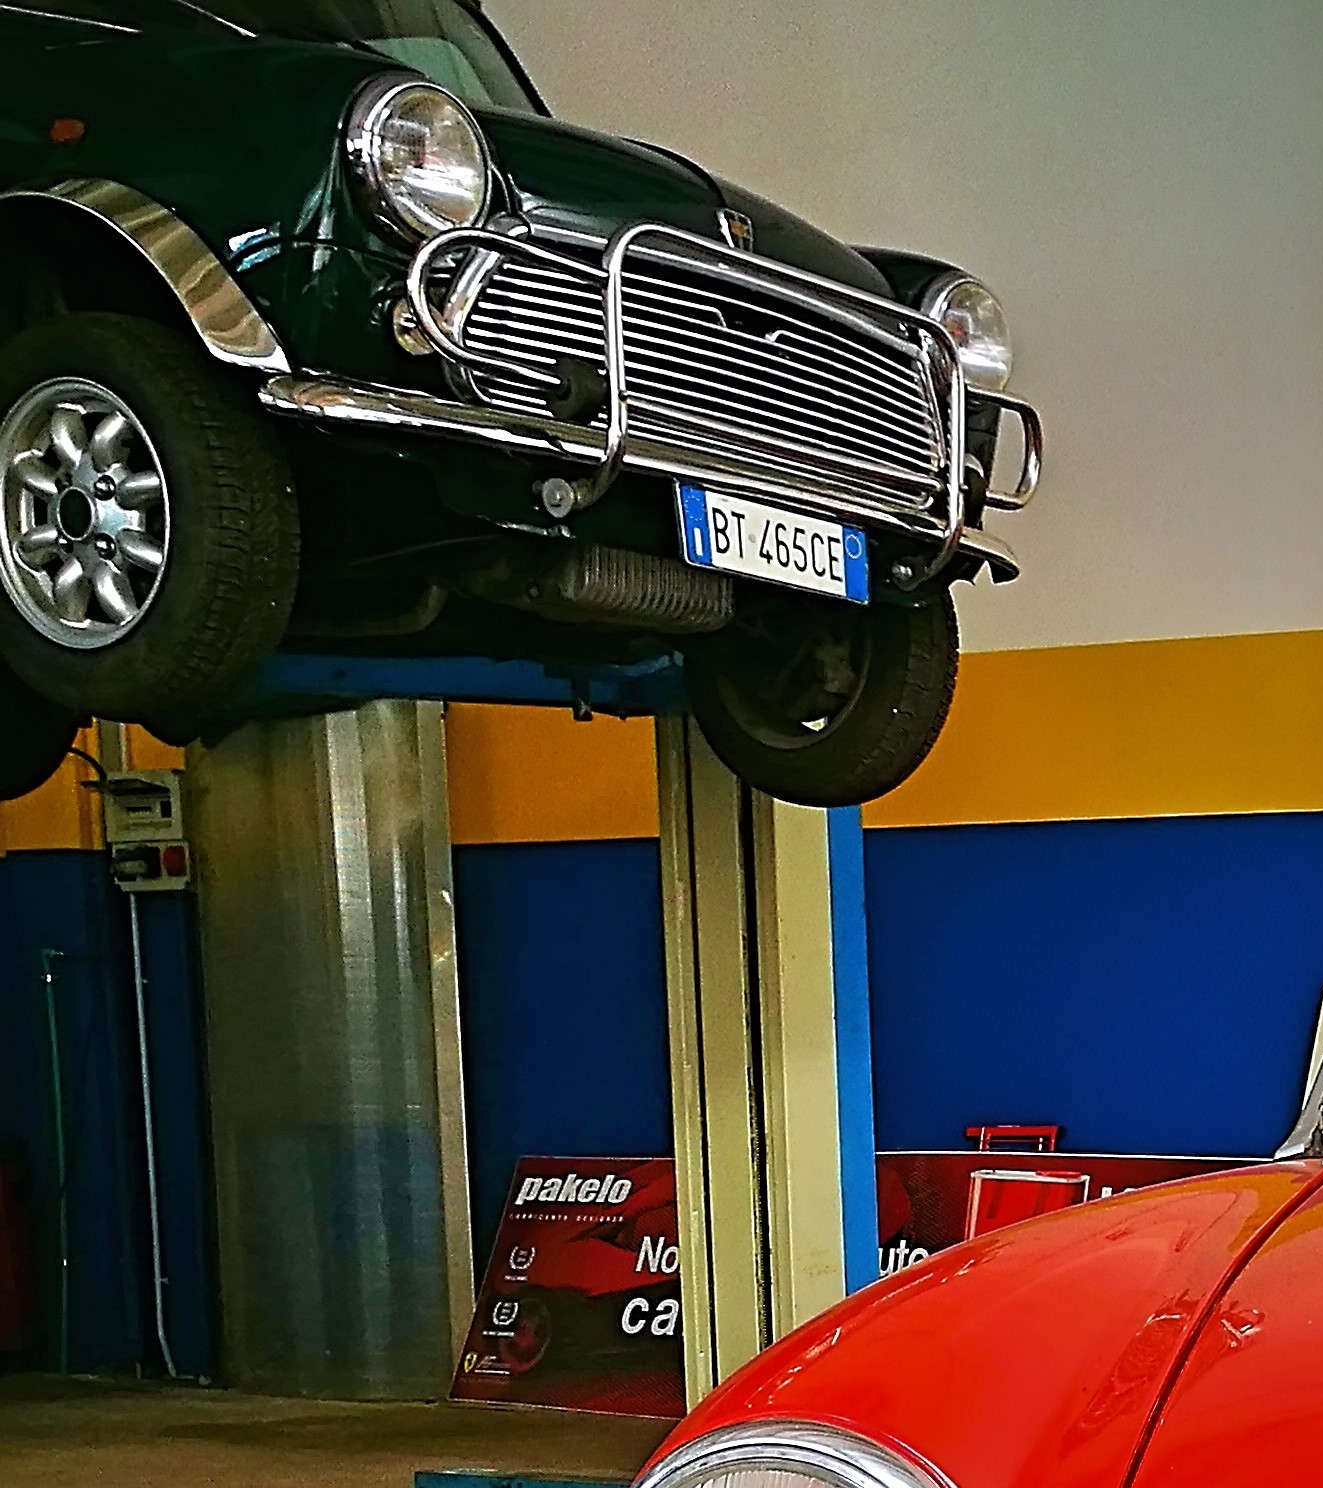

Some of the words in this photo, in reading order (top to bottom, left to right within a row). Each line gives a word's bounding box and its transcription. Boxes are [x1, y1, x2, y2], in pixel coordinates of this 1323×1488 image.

[711, 507, 746, 559] BT
[758, 519, 844, 583] 465CE
[514, 1173, 633, 1206] pakelo
[635, 1235, 681, 1274] No
[621, 1297, 681, 1336] ca
